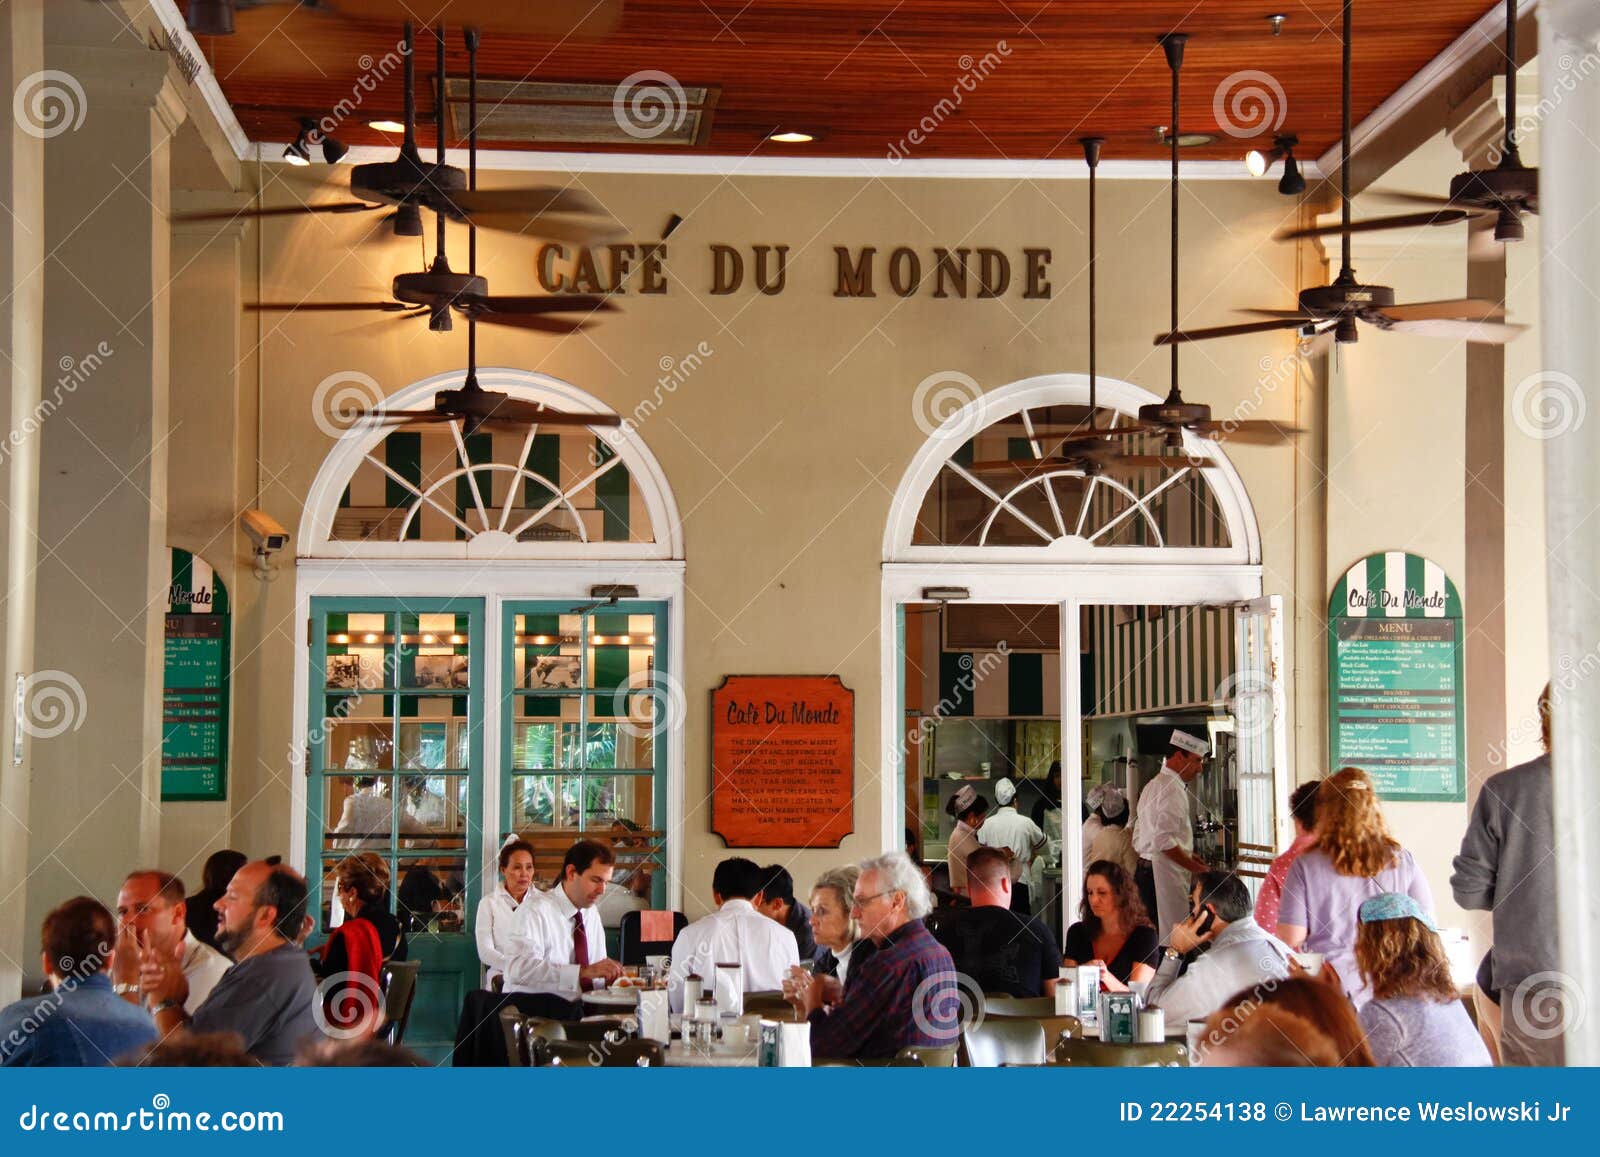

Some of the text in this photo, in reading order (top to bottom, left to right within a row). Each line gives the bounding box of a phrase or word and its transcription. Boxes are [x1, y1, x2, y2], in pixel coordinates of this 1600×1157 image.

[536, 214, 1052, 299] CAFÉ DU MONDE
[168, 584, 212, 605] Monde
[1349, 588, 1445, 608] Café Du Monde
[1378, 623, 1413, 633] MENU
[727, 700, 840, 725] Café Du Monde
